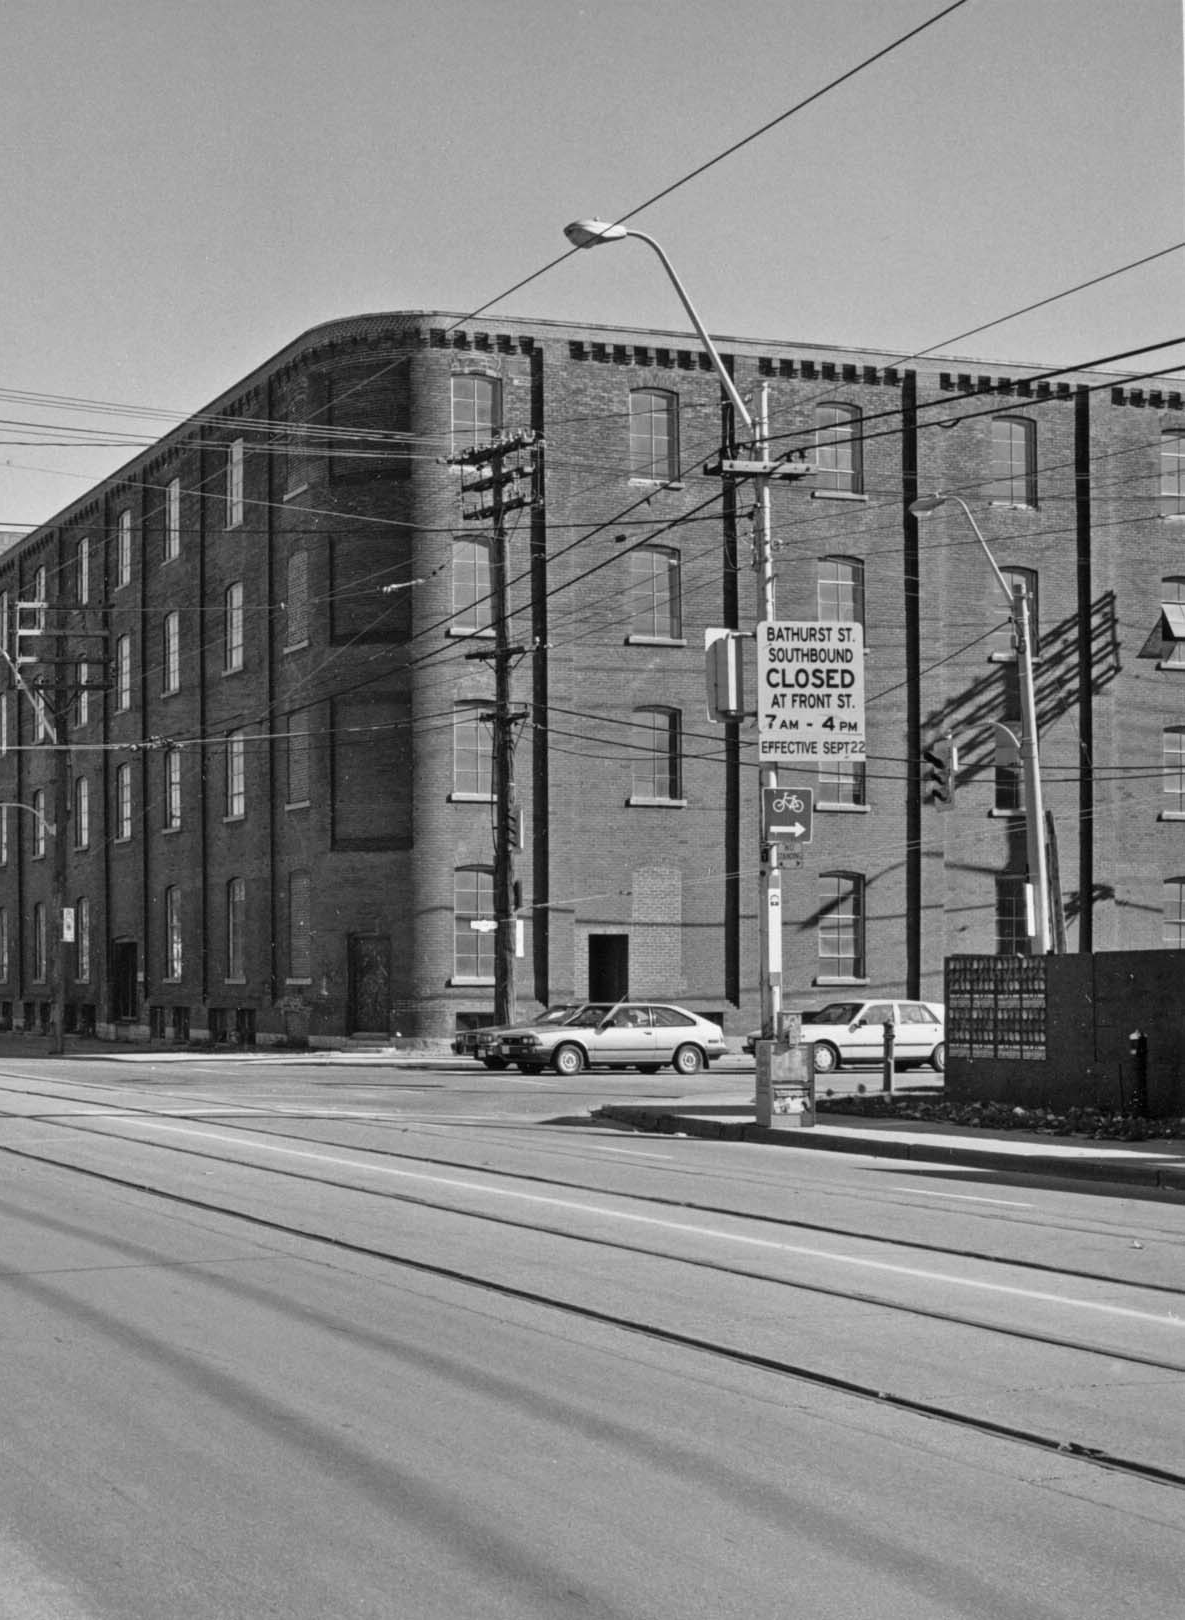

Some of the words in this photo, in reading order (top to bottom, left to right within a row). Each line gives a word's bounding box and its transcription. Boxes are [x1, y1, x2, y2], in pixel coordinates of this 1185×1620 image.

[766, 626, 833, 642] BATHURST
[837, 627, 856, 642] ST.
[767, 647, 854, 663] SOUTHBOUND
[765, 667, 855, 689] CLOSED
[770, 693, 787, 709] AT
[791, 693, 833, 709] FRONT
[837, 693, 856, 709] ST.
[765, 713, 777, 730] 7
[779, 719, 799, 730] AM
[821, 715, 836, 732] 4
[839, 720, 858, 732] PM
[761, 740, 818, 754] EFFECTIVE
